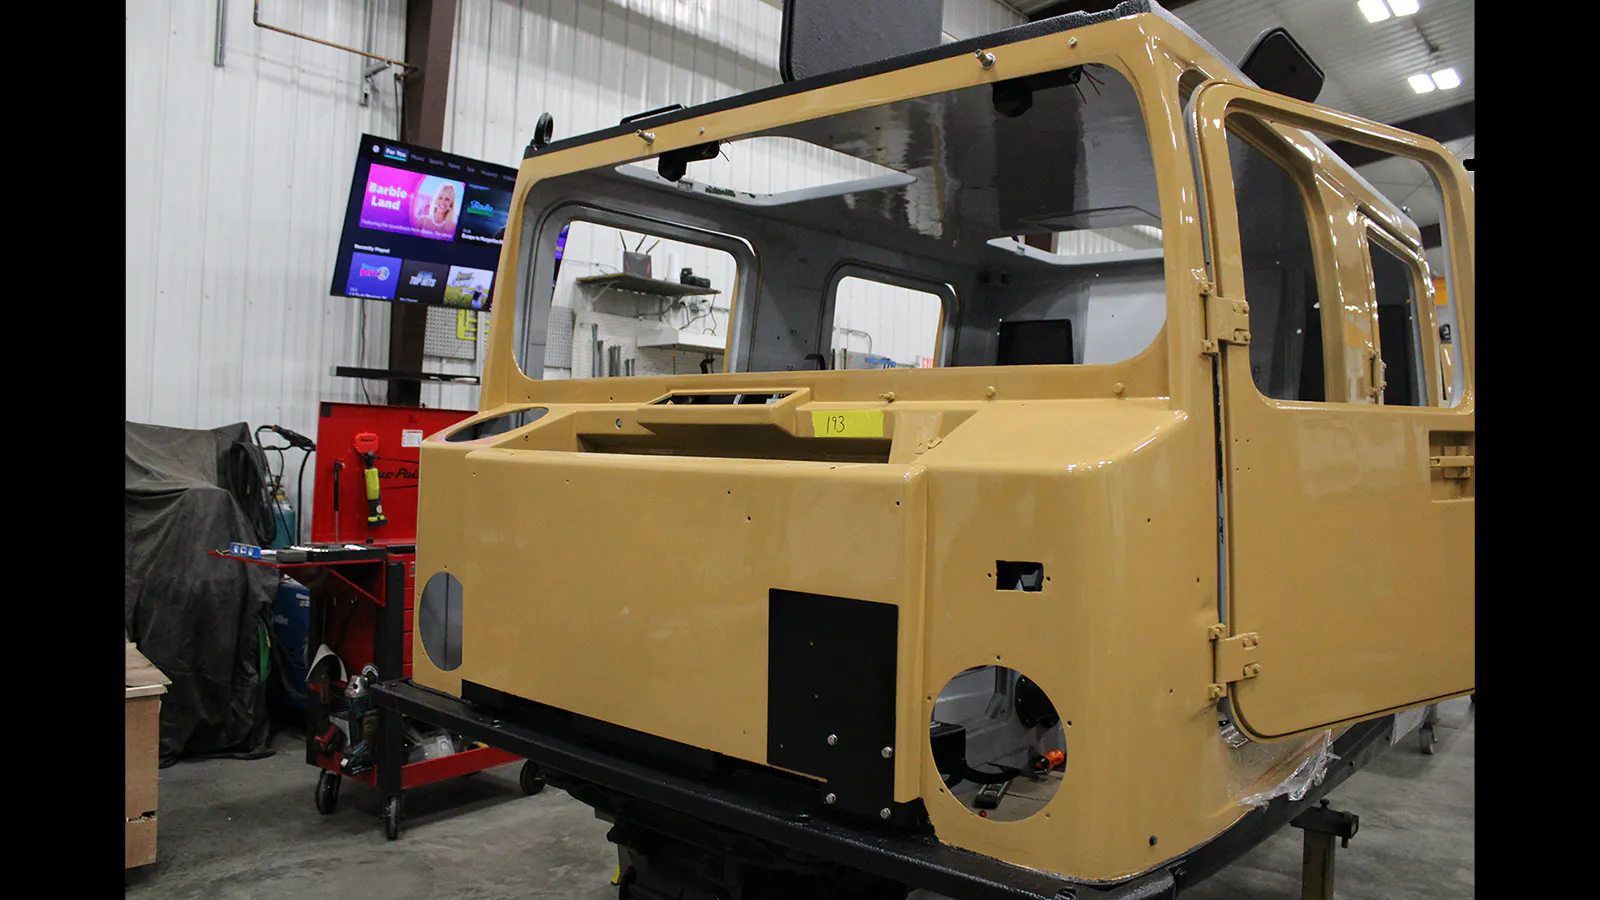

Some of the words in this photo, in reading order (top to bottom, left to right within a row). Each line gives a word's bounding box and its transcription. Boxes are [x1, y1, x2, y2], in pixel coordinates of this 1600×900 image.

[396, 150, 407, 158] You
[428, 157, 444, 166] Sports
[368, 182, 408, 199] Barbie
[371, 195, 401, 210] Land
[354, 243, 374, 252] Recently
[375, 246, 391, 254] Played
[409, 275, 422, 285] TOP
[826, 415, 845, 434] 193
